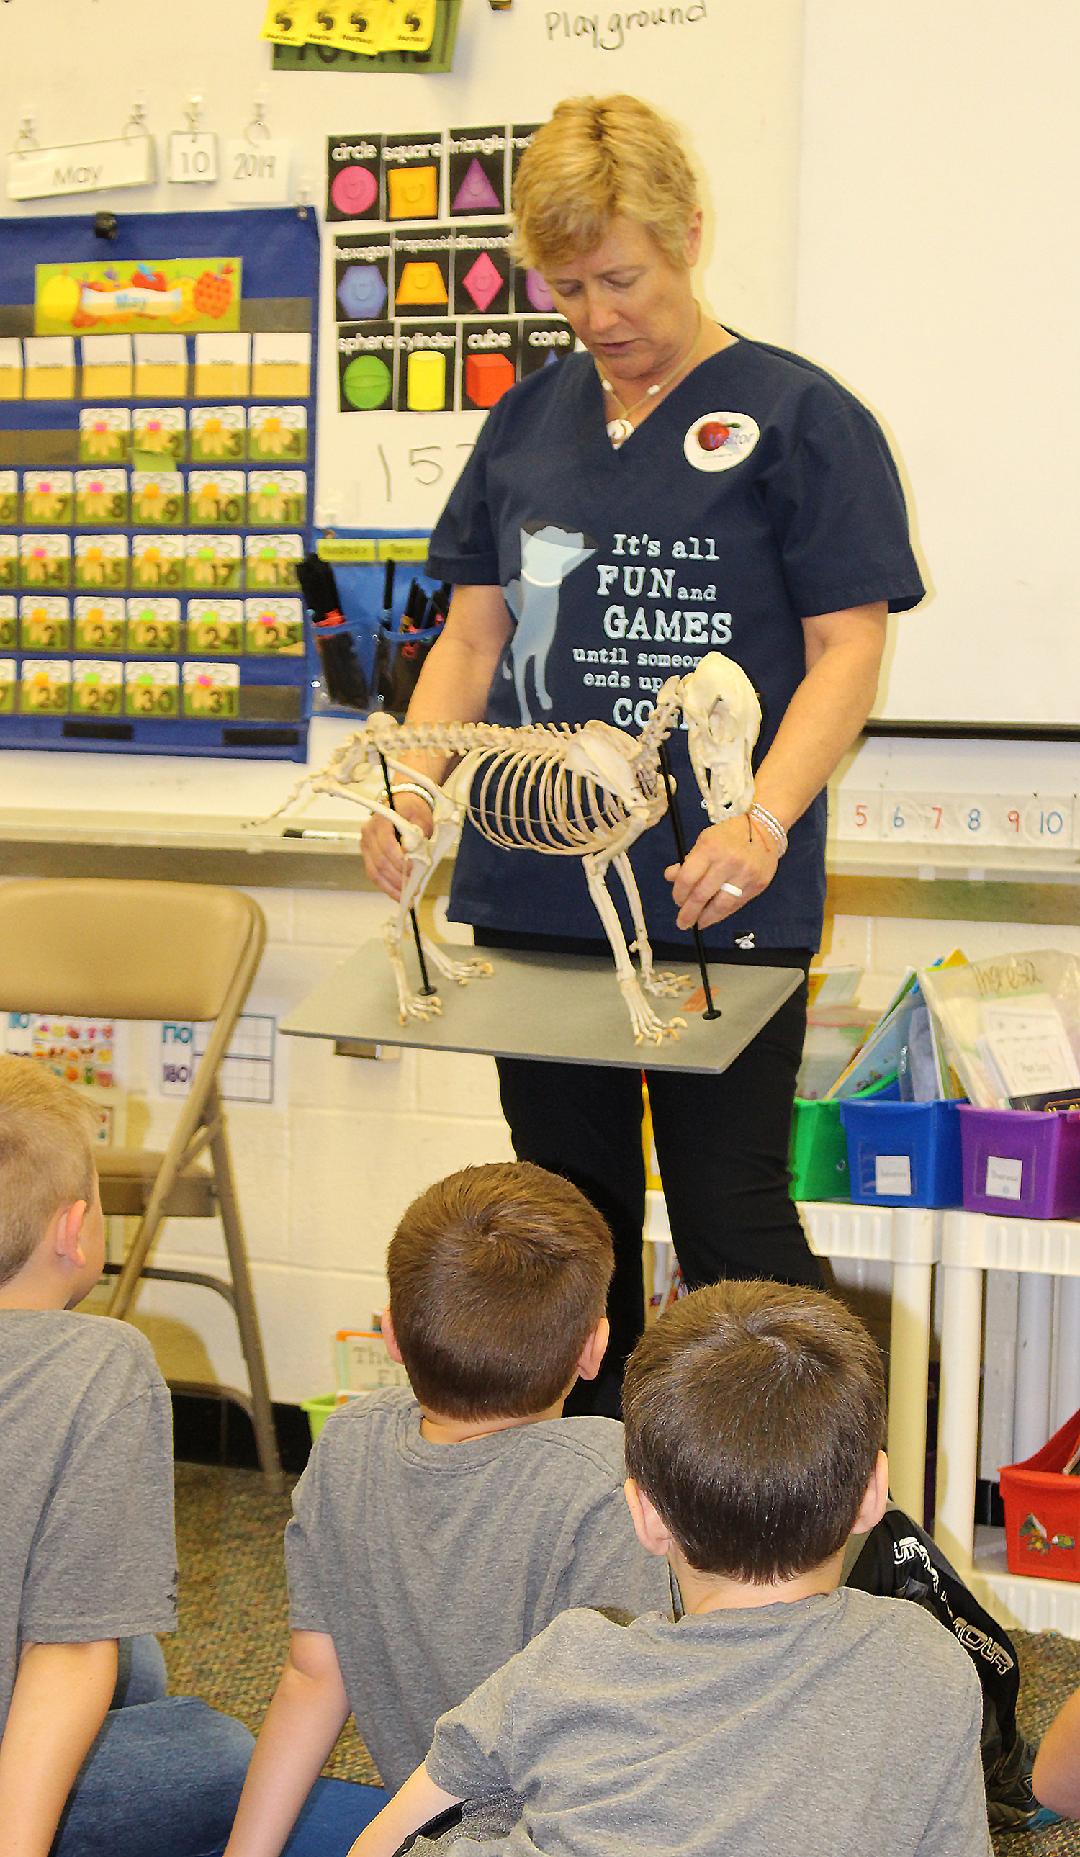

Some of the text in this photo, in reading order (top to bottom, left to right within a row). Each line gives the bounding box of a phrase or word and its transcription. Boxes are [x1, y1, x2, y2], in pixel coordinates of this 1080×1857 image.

[545, 3, 707, 51] Playground
[180, 150, 210, 174] 10
[331, 142, 378, 162] circle
[382, 142, 442, 164] square
[339, 333, 394, 356] sphere
[398, 332, 457, 352] cylinder
[467, 328, 512, 350] cube
[528, 330, 571, 348] cone
[168, 434, 182, 458] 2
[229, 432, 243, 457] 3
[376, 443, 476, 502] 15
[111, 494, 125, 519] 8
[164, 498, 180, 522] 9
[214, 498, 241, 523] 10
[611, 533, 720, 561] It's all
[99, 560, 123, 584] 15
[156, 560, 181, 585] 16
[209, 560, 236, 586] 17
[596, 564, 717, 602] FUN and
[92, 623, 123, 647] 22
[145, 623, 175, 649] 23
[207, 625, 239, 649] 24
[603, 604, 733, 645] GAMES
[572, 647, 630, 666] until
[583, 670, 663, 693] ends up
[87, 686, 117, 711] 29
[140, 687, 174, 712] 30
[209, 688, 235, 714] 31
[854, 803, 1064, 835] 5 6 7 8 9 10
